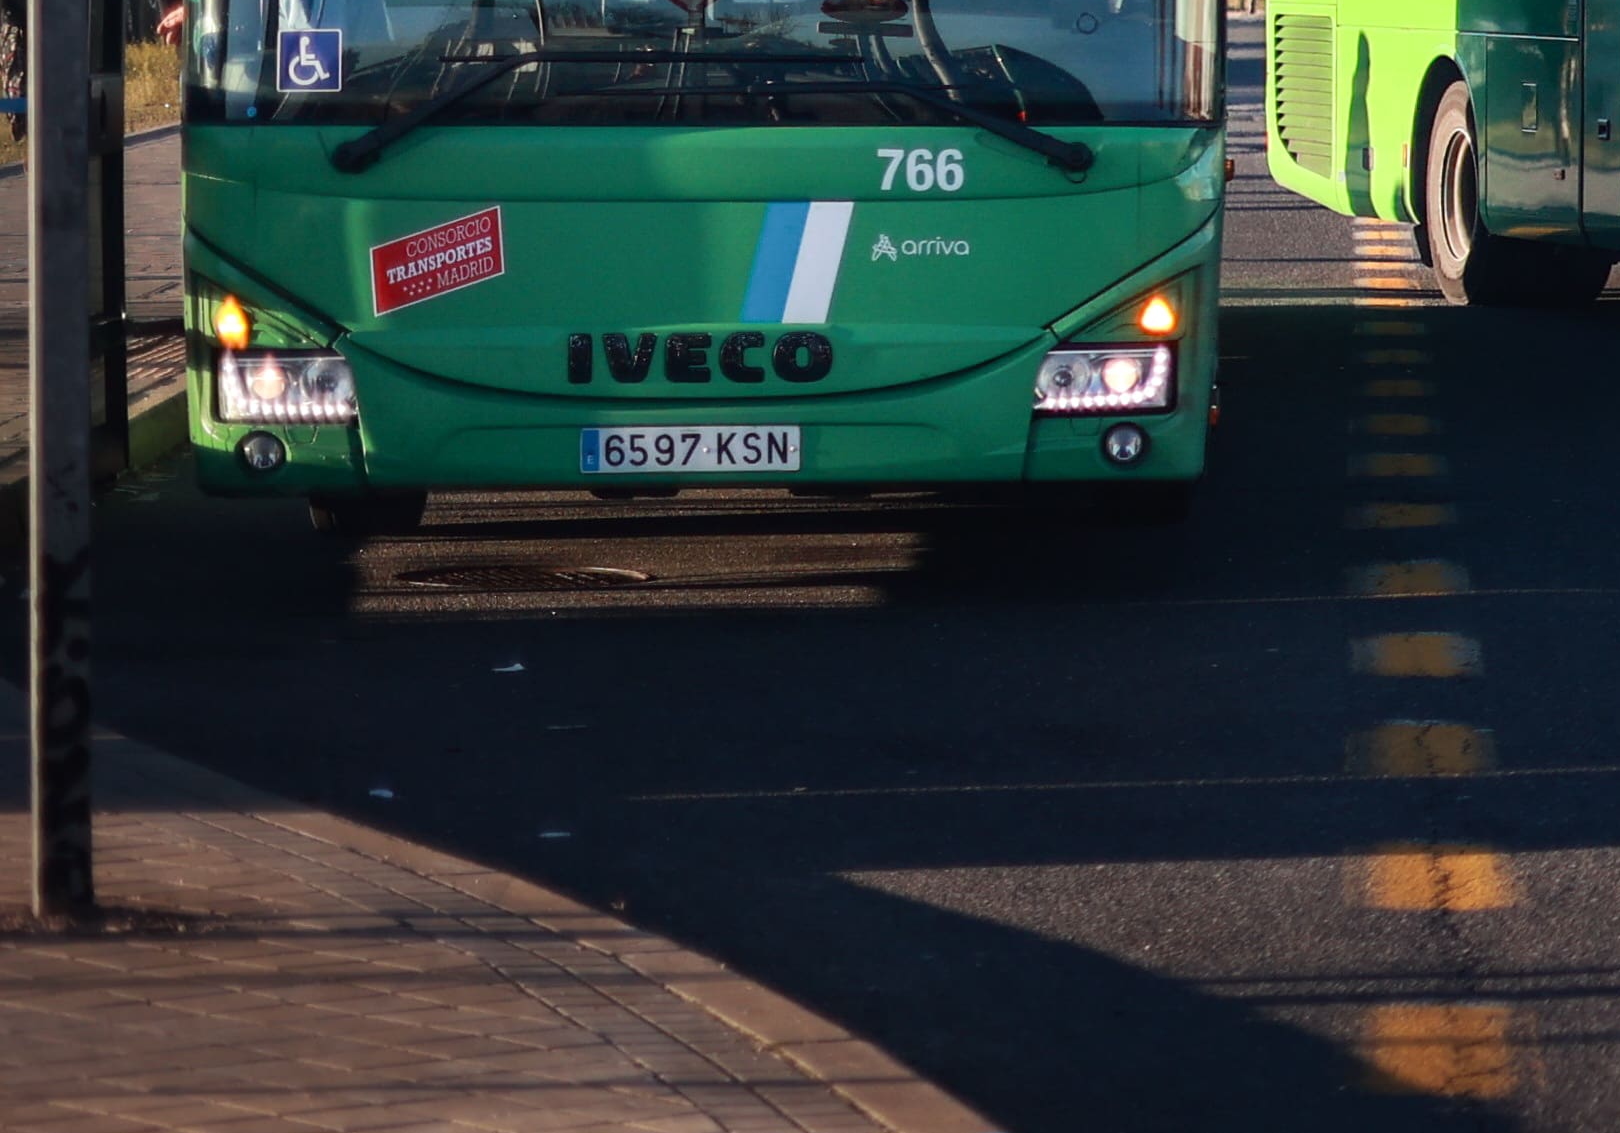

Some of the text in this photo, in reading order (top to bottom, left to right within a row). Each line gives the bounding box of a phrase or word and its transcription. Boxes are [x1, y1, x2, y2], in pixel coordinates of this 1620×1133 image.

[877, 148, 965, 192] 766
[405, 216, 492, 258] CONSORCIO
[901, 235, 971, 256] arriva
[386, 235, 493, 285] TRANSPORTES
[436, 255, 494, 289] MADRID
[567, 331, 834, 384] IVECO
[604, 431, 789, 467] 6597 KSN
